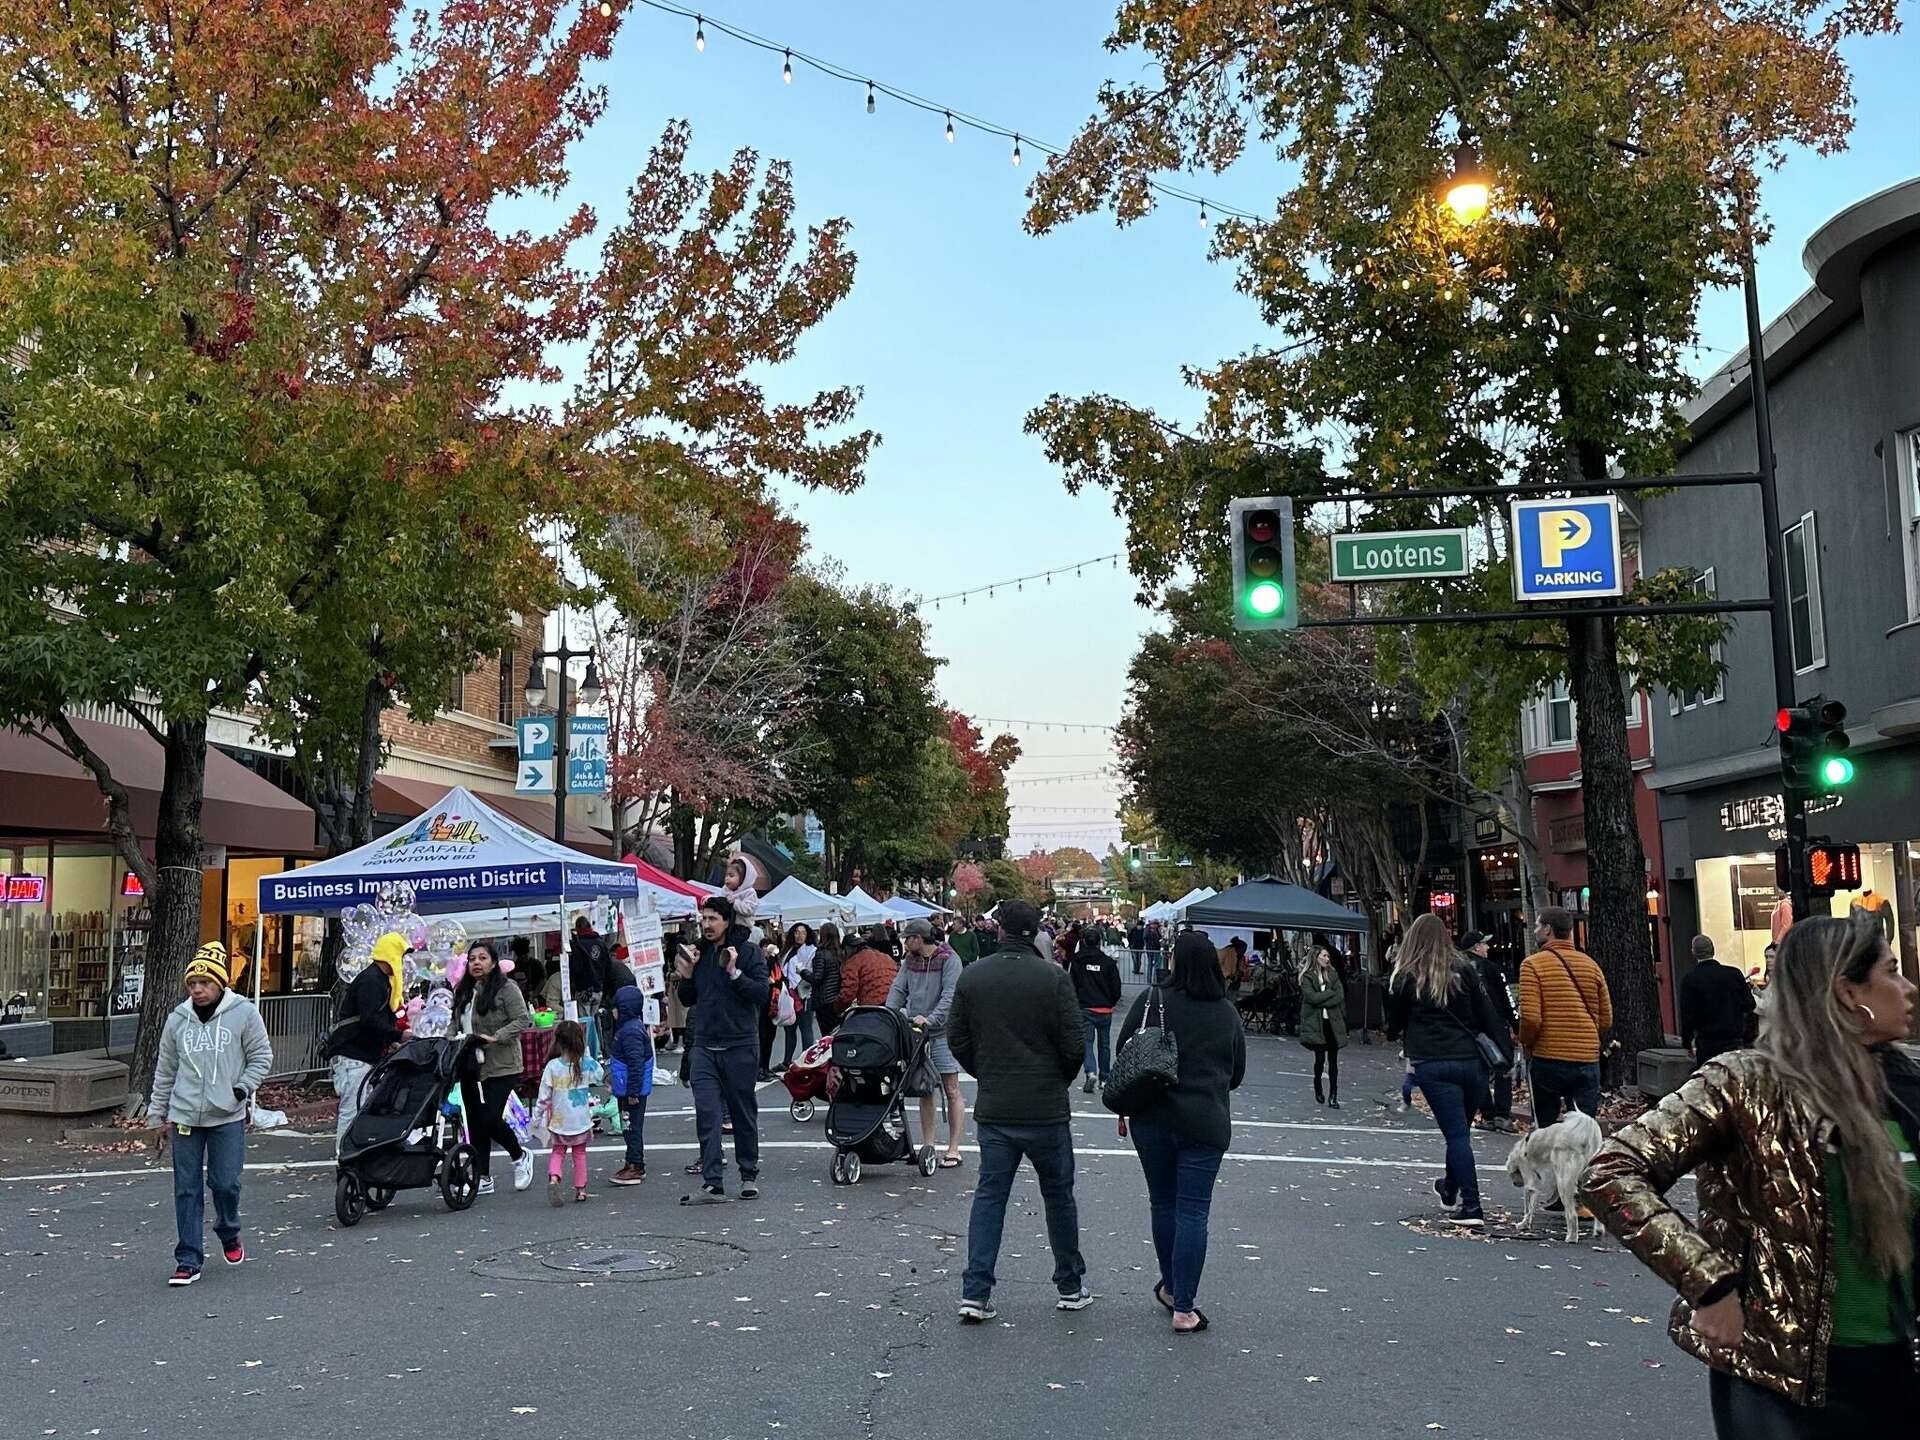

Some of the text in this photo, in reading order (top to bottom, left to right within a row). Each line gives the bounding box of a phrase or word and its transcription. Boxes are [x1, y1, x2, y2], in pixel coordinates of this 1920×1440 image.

[1539, 510, 1592, 568] P
[1352, 543, 1446, 570] Lootens
[1535, 570, 1603, 586] PARKING
[572, 722, 607, 731] PARKING
[524, 723, 550, 754] P
[571, 779, 603, 788] GARAGE
[574, 772, 587, 780] 4th
[371, 844, 480, 859] SAN RAFAEL
[362, 855, 449, 867] DOWNTOWN
[274, 868, 547, 900] Business Improvement District
[567, 869, 590, 885] Business
[8, 881, 41, 899] HAIR
[8, 1004, 37, 1015] Welcome
[117, 994, 133, 1010] SPA
[183, 1026, 232, 1053] GAP
